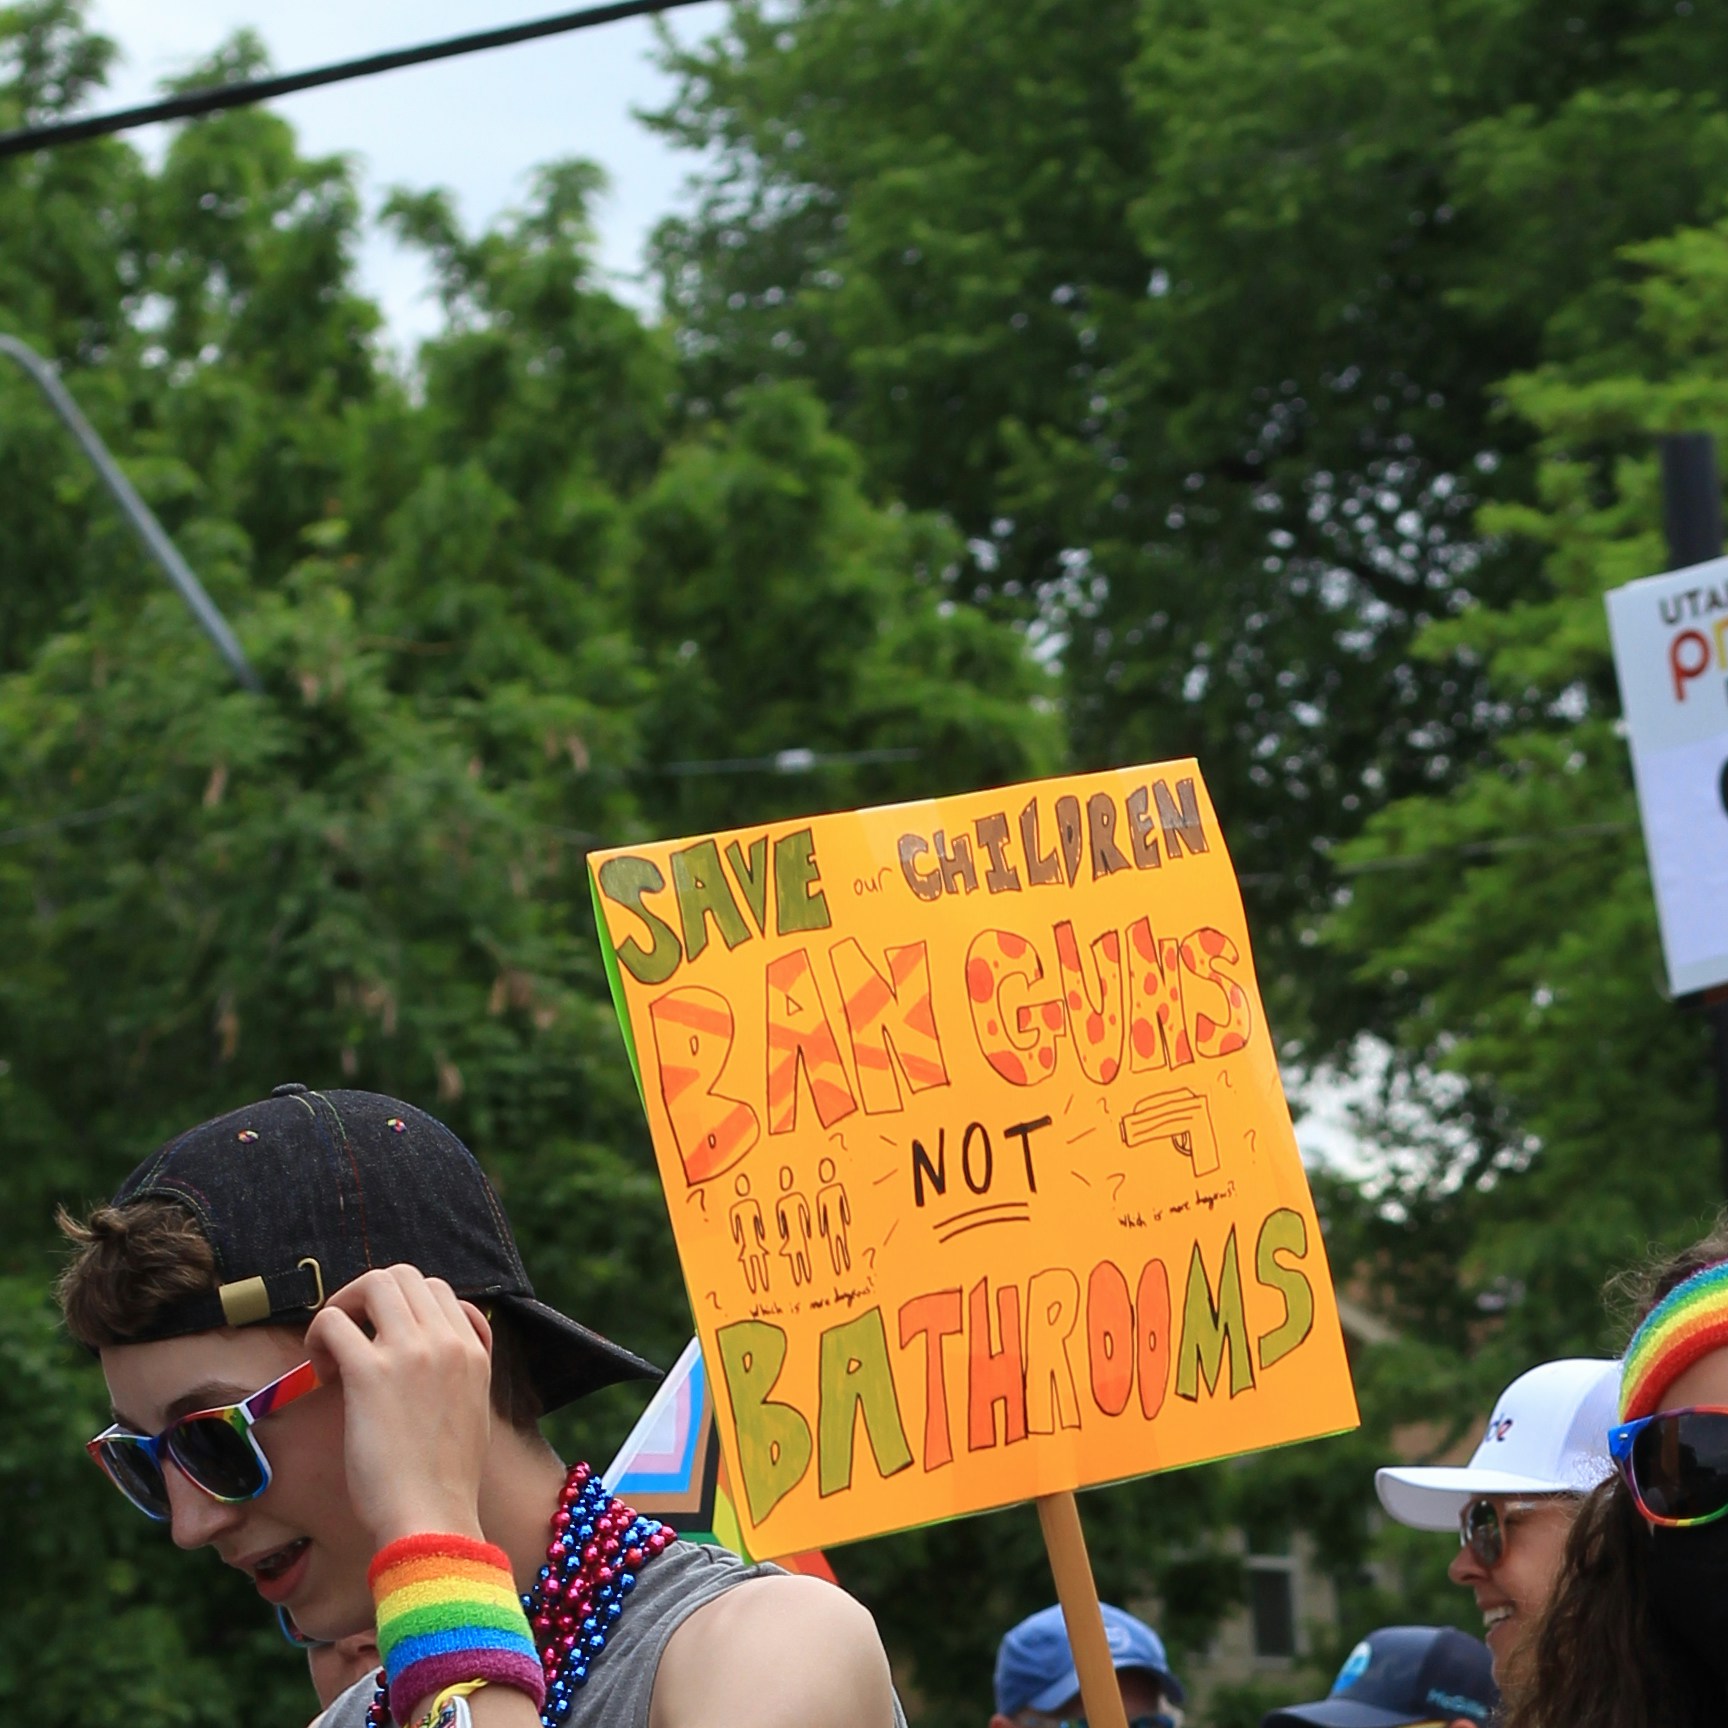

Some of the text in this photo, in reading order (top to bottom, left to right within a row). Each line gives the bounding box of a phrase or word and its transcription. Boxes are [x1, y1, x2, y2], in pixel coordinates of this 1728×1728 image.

[599, 777, 1210, 985] SAVE our CHILDREN
[649, 915, 1253, 1186] BAN GUNS
[911, 1115, 1053, 1208] NOT
[717, 1207, 1315, 1528] BATHROOMS
